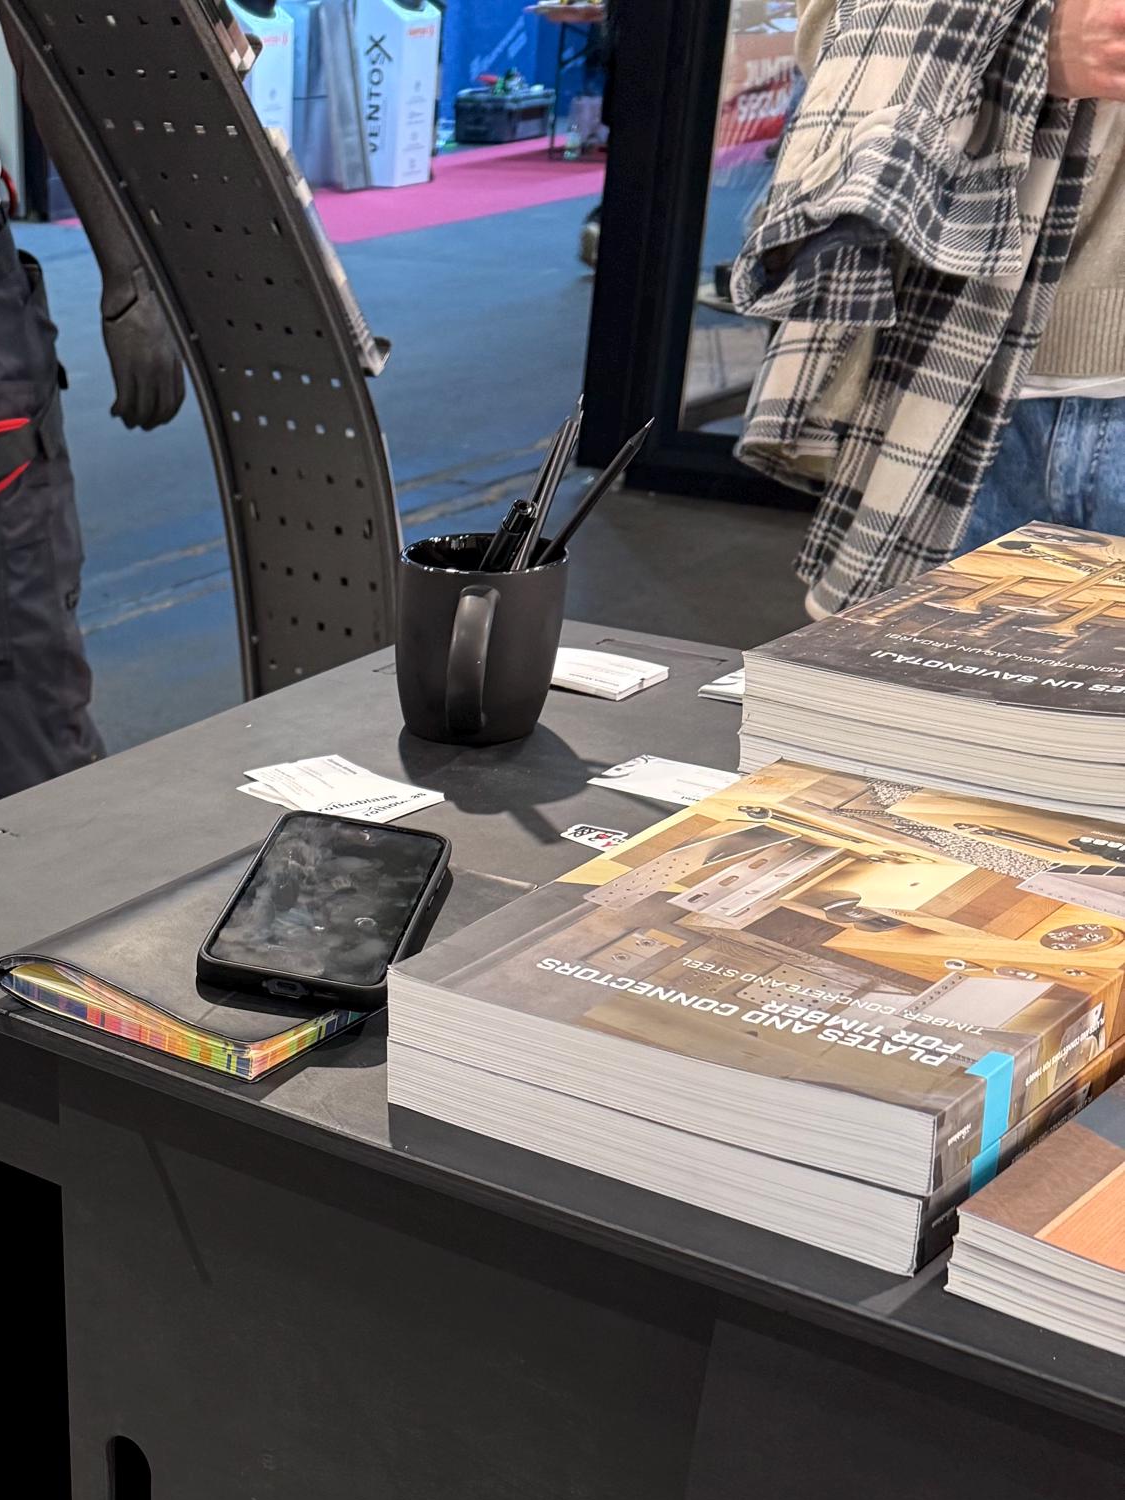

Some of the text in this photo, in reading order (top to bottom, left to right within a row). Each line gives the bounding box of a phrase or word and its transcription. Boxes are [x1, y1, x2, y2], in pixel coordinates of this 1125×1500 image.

[1041, 678, 1085, 690] UN
[318, 794, 398, 812] rothoblaas
[536, 957, 950, 1067] PLATES AND CONNECTORS
[681, 957, 983, 1036] TIMBER, CONCRETE AND STEEL
[761, 1000, 964, 1055] FOR TIMBER
